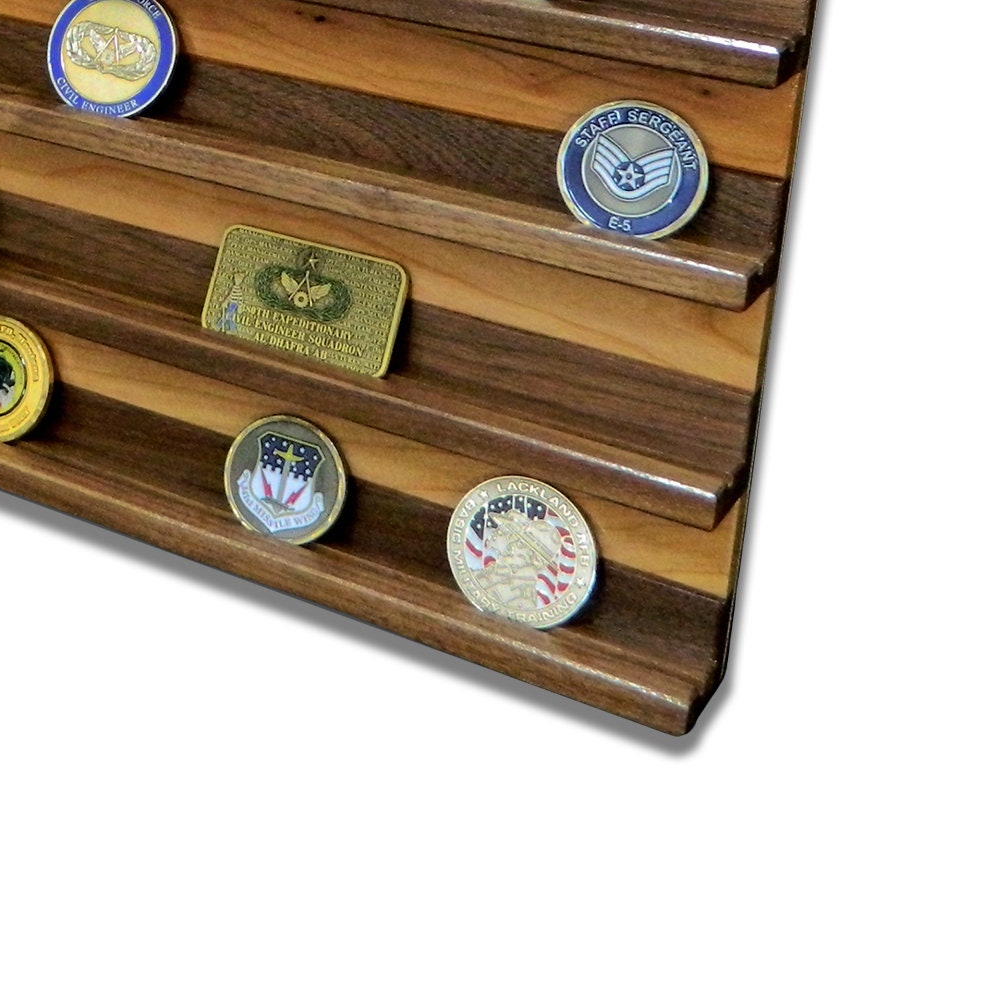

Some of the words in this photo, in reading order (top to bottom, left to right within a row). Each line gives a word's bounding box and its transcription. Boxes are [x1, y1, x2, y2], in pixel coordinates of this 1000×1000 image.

[57, 77, 79, 105] CIVIL
[81, 100, 139, 115] ENGINEER
[575, 110, 619, 148] STAFF
[627, 110, 698, 170] SERGEANT
[608, 216, 631, 231] E-5
[255, 319, 305, 340] ENGINEER
[308, 335, 363, 358] SQUADRON
[273, 311, 354, 341] EXPEDITIONARY
[254, 332, 267, 344] AL
[270, 337, 312, 355] DHAFRA
[313, 347, 328, 360] AB
[452, 500, 476, 543] BASIC
[497, 482, 578, 527] LACKLAND
[576, 532, 590, 567] AFB
[452, 551, 499, 611] MILITARY
[507, 593, 577, 622] TRAINING
